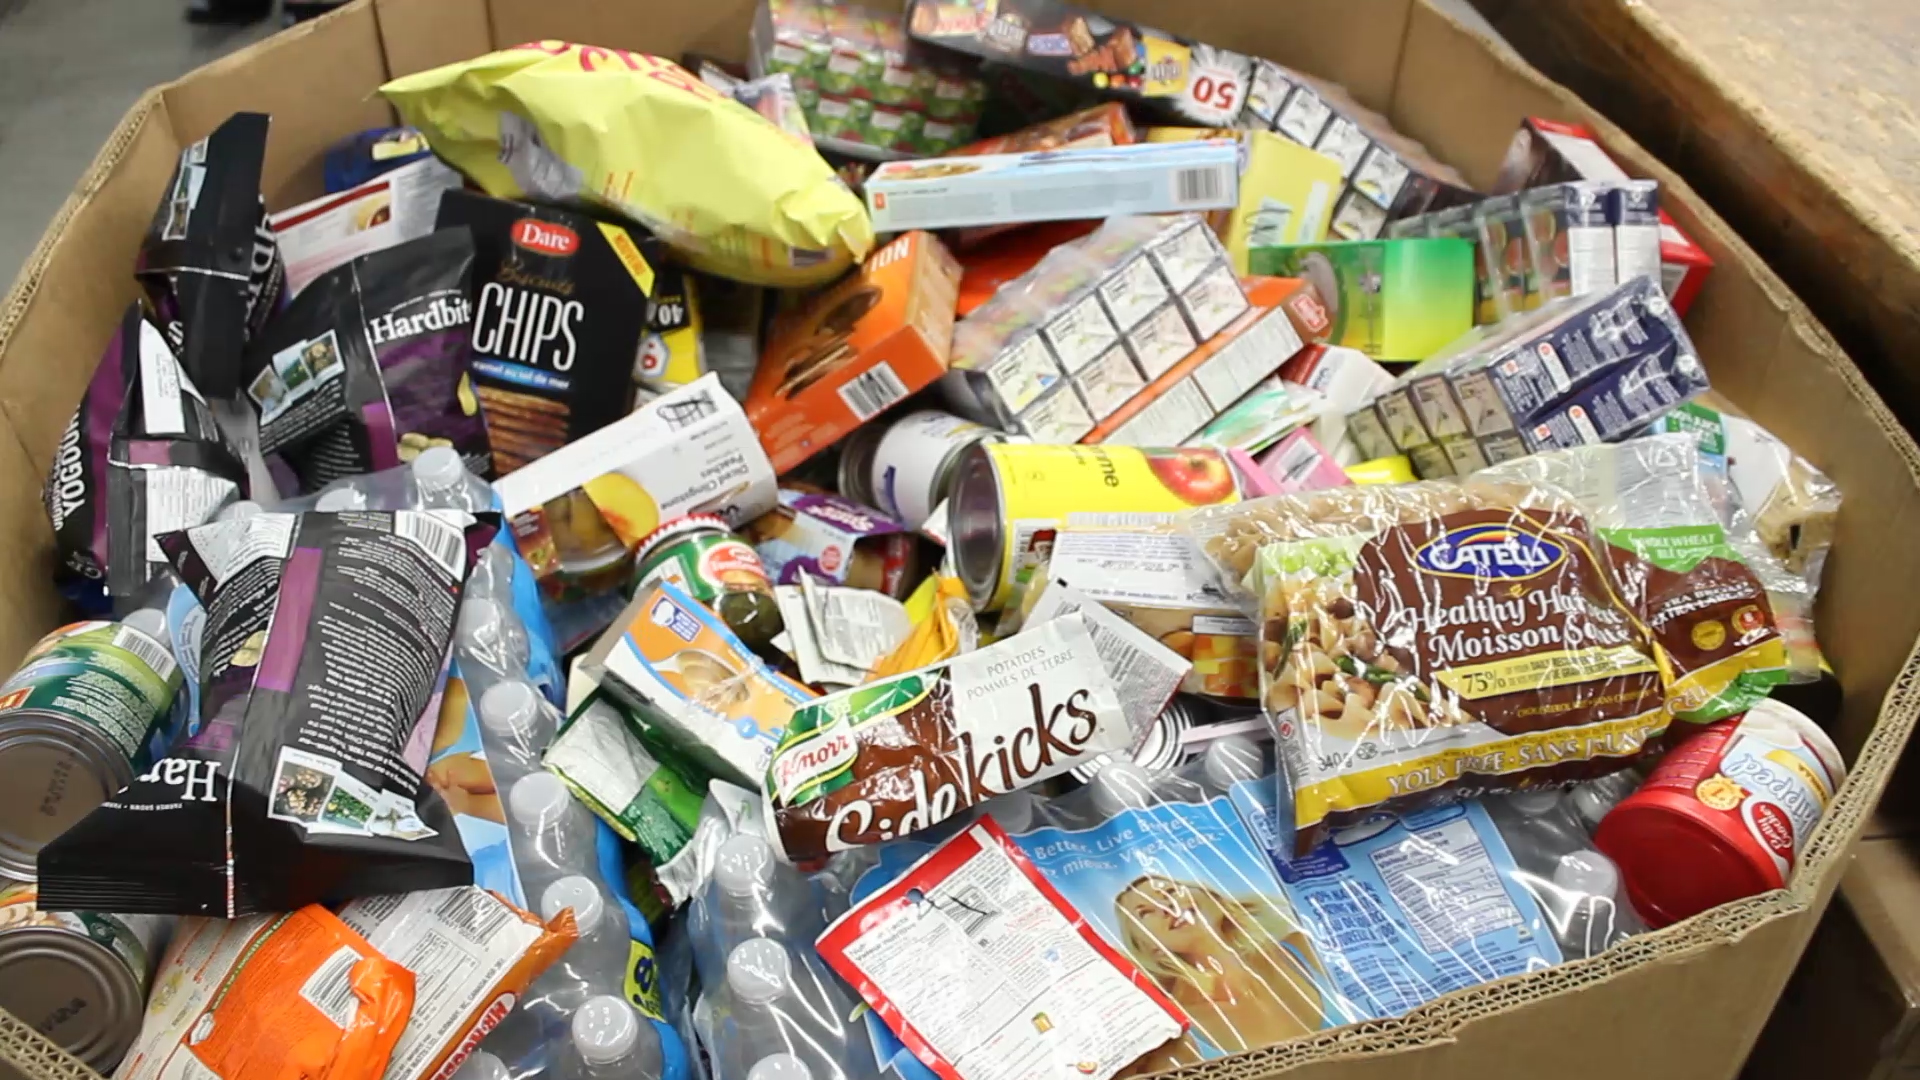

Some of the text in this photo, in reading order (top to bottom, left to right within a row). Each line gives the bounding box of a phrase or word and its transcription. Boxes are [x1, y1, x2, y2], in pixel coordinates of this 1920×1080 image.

[1192, 74, 1237, 111] 50
[521, 223, 570, 251] Dare
[369, 296, 472, 345] Hardbit
[471, 281, 585, 372] CHIPS
[718, 464, 749, 487] Diced
[1671, 533, 1716, 546] WHEAT
[1428, 543, 1551, 570] CATELLI
[1401, 593, 1526, 635] Healthy
[986, 645, 1047, 678] POTATOES
[1427, 623, 1562, 668] Moisson
[966, 672, 1019, 701] POMMES
[1021, 666, 1039, 682] DE
[1043, 649, 1077, 672] TERRE
[1461, 671, 1507, 696] 75%
[775, 733, 850, 788] Knorr
[1519, 737, 1579, 765] SANS
[1097, 829, 1135, 851] Live
